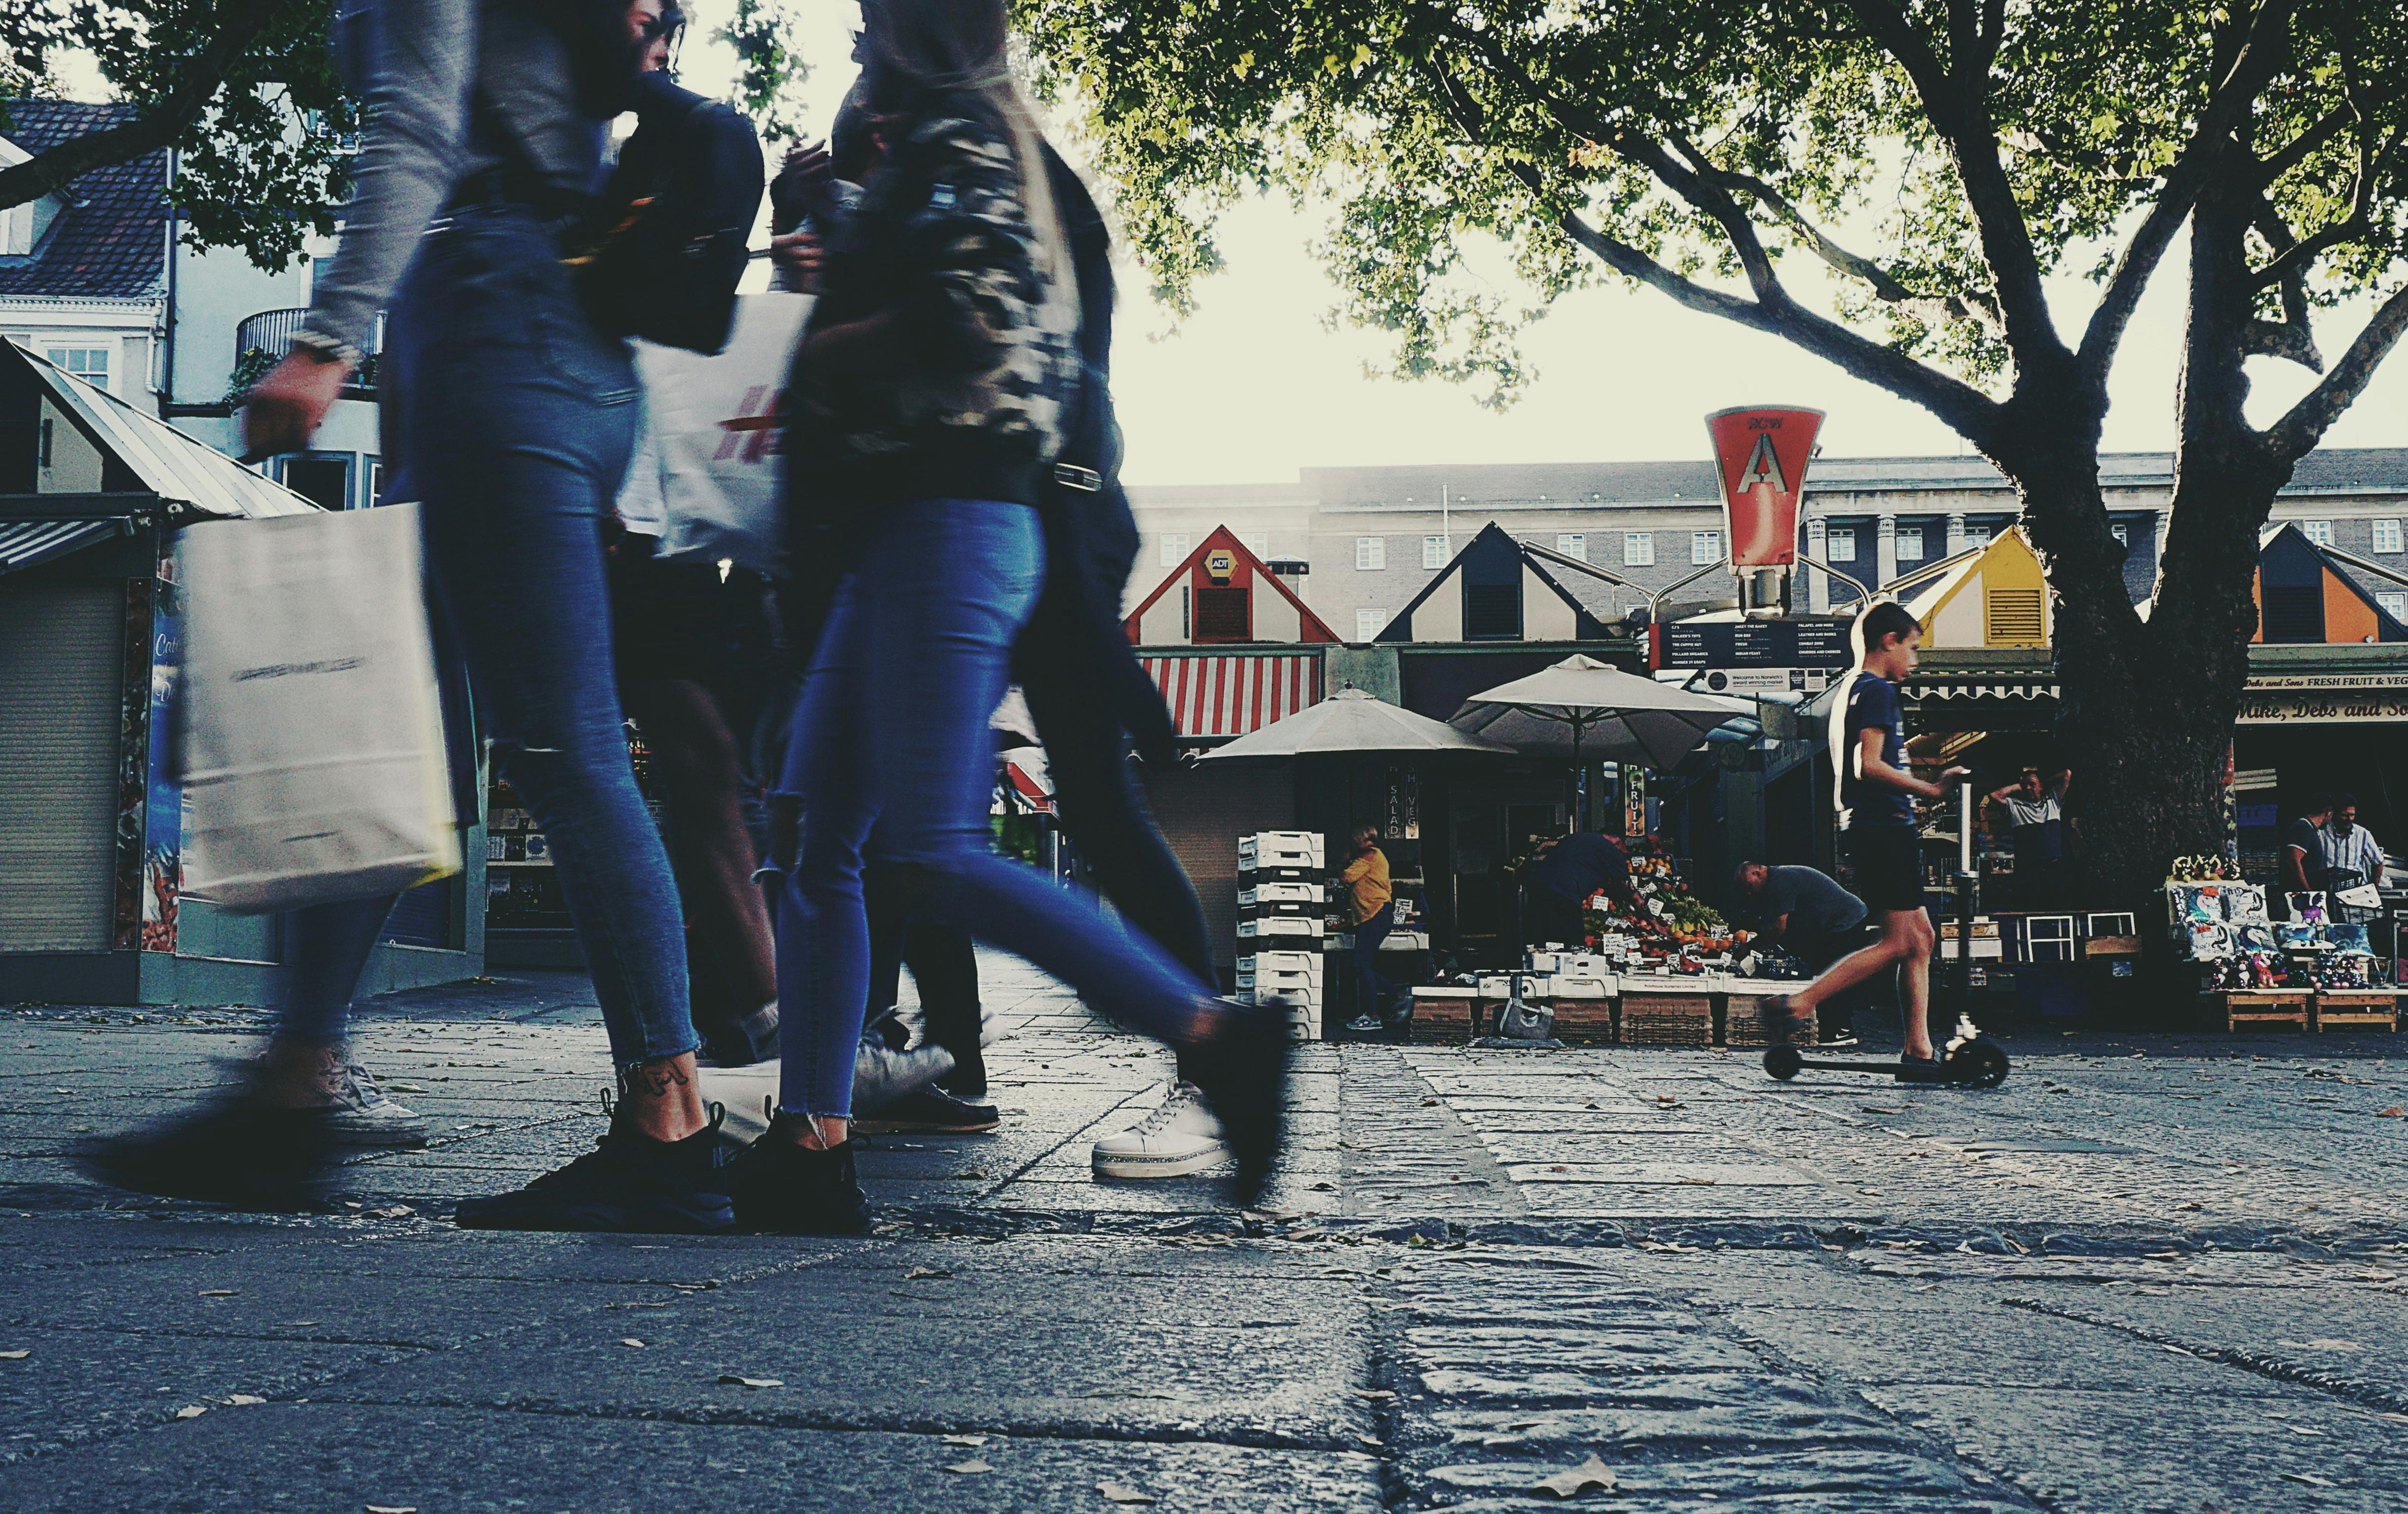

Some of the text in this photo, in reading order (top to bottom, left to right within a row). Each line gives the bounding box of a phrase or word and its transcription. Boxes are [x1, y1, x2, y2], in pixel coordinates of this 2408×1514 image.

[1737, 433, 1789, 493] A
[2307, 678, 2341, 686] FRESH
[2342, 677, 2374, 686] FRUIT
[2237, 700, 2286, 721] Mike,
[2291, 700, 2338, 718] Debs
[2344, 699, 2382, 717] and
[1390, 785, 1398, 834] SALAD
